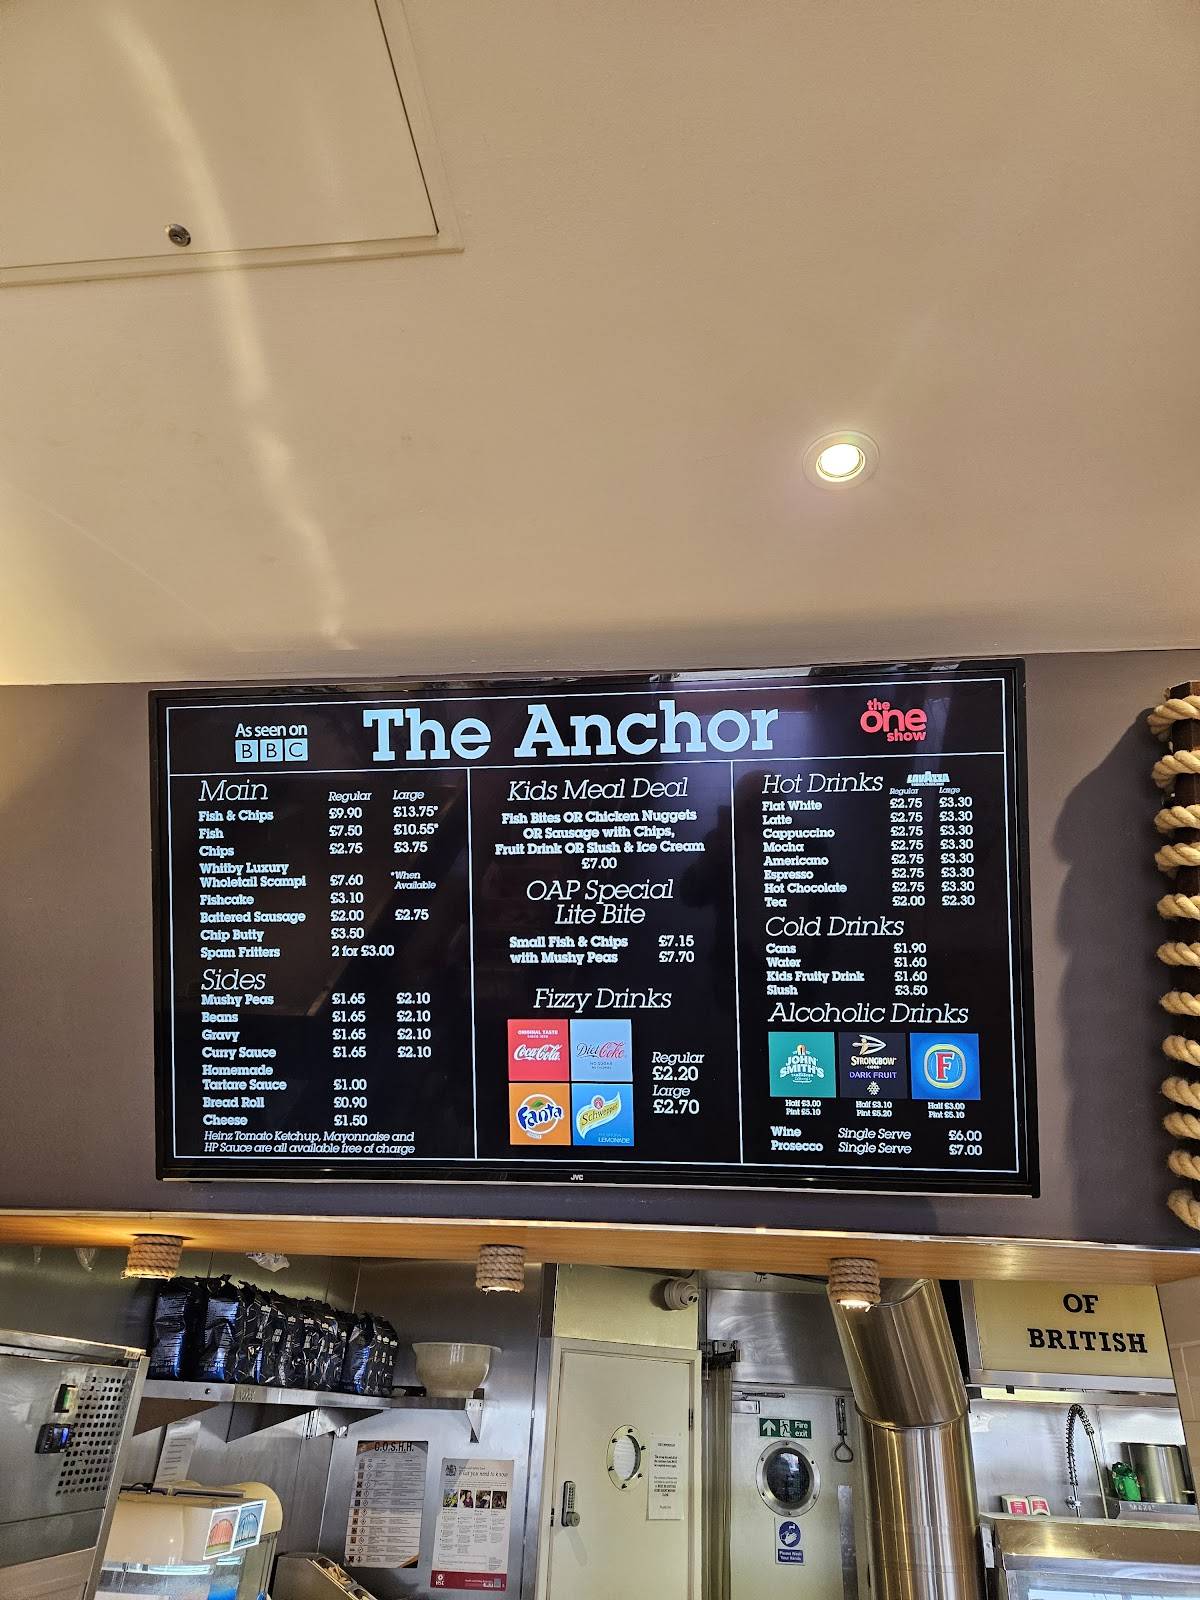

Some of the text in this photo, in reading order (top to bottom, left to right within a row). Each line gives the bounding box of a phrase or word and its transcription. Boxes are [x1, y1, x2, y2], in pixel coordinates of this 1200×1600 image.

[867, 698, 890, 711] the
[860, 708, 928, 733] one
[235, 723, 307, 737] As seen on
[363, 700, 779, 761] The Anchor
[887, 729, 926, 741] show
[235, 738, 308, 762] BBC
[507, 777, 688, 801] Kids Meal Deal
[762, 772, 883, 793] Hot Drinks
[199, 779, 268, 801] Main
[328, 790, 424, 803] Regular Large
[889, 788, 919, 796] Regular
[762, 797, 972, 811] Flat White £2.75 £3.30
[199, 811, 224, 821] Fish
[226, 810, 235, 821] &
[238, 810, 274, 823] Chips
[329, 807, 362, 819] £9.90
[502, 809, 697, 824] Fish Bites OR Chicken Nuggets
[763, 815, 792, 825] Latte
[199, 828, 224, 839] Fish
[329, 825, 362, 836] £7.50
[523, 825, 675, 840] OR Sausage with Chips,
[763, 828, 835, 840] Cappuccino
[199, 846, 234, 858] Chips
[763, 842, 804, 852] Mocha
[581, 857, 617, 869] £7.00
[763, 856, 829, 866] Americano
[199, 863, 289, 875] Whitby Luxury
[764, 870, 813, 881] Espresso
[200, 874, 363, 888] Wholetail Scampi £7.60
[394, 881, 436, 889] Available
[200, 894, 254, 905] Fishcake
[527, 879, 673, 906] OAP Special
[765, 895, 975, 907] Tea £2.00 £2.30
[200, 909, 429, 924] Battered Sausage £2.00 £2.75
[555, 902, 645, 924] Lite Bite
[766, 916, 904, 936] Cold Drinks
[510, 935, 694, 949] Small Fish & Chips £7.15
[766, 943, 926, 953] Cans £1.90
[766, 957, 801, 967] Water
[201, 969, 266, 990] Sides
[767, 971, 865, 983] Kids Fruity Drink
[767, 985, 927, 995] Slush £3.50
[201, 992, 430, 1007] Mushy Peas £1.65 £2.10
[533, 988, 671, 1013] Fizzy Drinks
[202, 1012, 238, 1022] Beans
[768, 1003, 968, 1023] Alcoholic Drinks
[202, 1029, 240, 1042] Gravy
[599, 1042, 625, 1058] Coke
[652, 1052, 704, 1065] Regular
[786, 1056, 819, 1066] JOHN
[652, 1066, 698, 1081] £2.20
[652, 1085, 690, 1099] Large
[653, 1099, 699, 1114] £2.70
[203, 1114, 248, 1125] Cheese
[517, 1104, 563, 1130] Fanta
[204, 1131, 414, 1144] Heinz Tomato Ketchup, Mayonnaise and
[770, 1126, 982, 1141] Wine Single Serve £6.00
[204, 1142, 219, 1152] HP
[220, 1143, 252, 1152] Sauce
[274, 1143, 287, 1152] all
[289, 1141, 340, 1153] available
[341, 1141, 362, 1153] free
[364, 1143, 374, 1153] of
[376, 1144, 415, 1155] charge
[771, 1140, 982, 1155] Prosecco £7.00
[1063, 1294, 1098, 1313] OF
[1027, 1328, 1147, 1353] BRITISH
